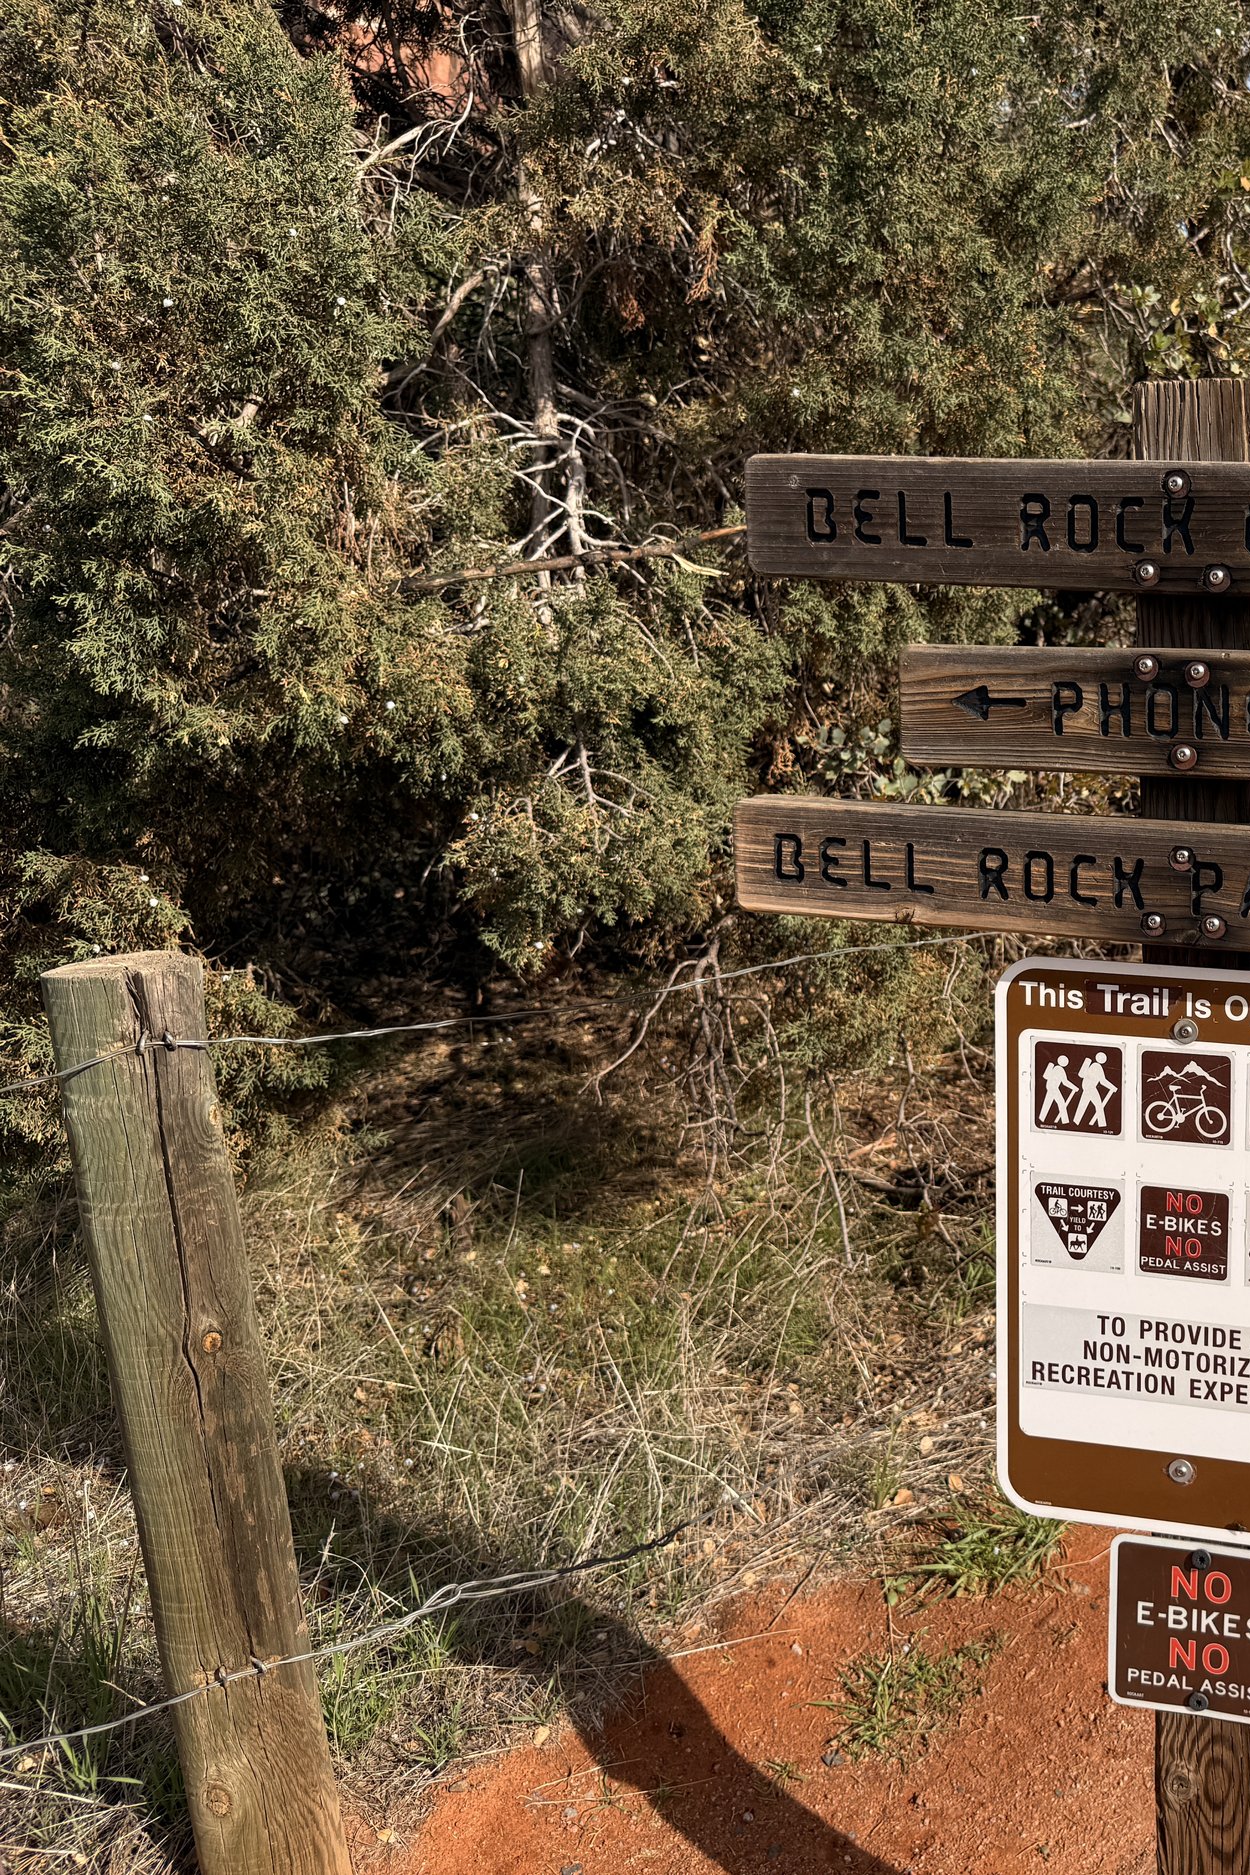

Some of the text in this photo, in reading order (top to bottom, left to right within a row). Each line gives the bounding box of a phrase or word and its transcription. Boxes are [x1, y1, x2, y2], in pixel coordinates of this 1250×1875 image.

[805, 487, 974, 549] BELL
[1020, 492, 1196, 556] ROCK
[774, 833, 935, 895] BELL
[979, 846, 1145, 911] ROCK
[1018, 980, 1084, 1010] This
[1096, 983, 1171, 1017] Trail
[1186, 991, 1212, 1020] Is
[1040, 1184, 1115, 1201] TRAIL COURTESY
[1166, 1191, 1203, 1215] NO
[1069, 1216, 1087, 1224] YIELD
[1074, 1224, 1082, 1232] TO
[1146, 1213, 1222, 1236] E-BIKES
[1165, 1235, 1202, 1259] NO
[1140, 1255, 1227, 1275] PEDAL ASSIST
[1097, 1314, 1126, 1338] TO
[1139, 1319, 1242, 1351] PROVIDE
[1031, 1361, 1176, 1396] RECREATION
[1170, 1565, 1233, 1605] NO
[1169, 1636, 1230, 1676] NO
[1127, 1667, 1194, 1691] PEDAL
